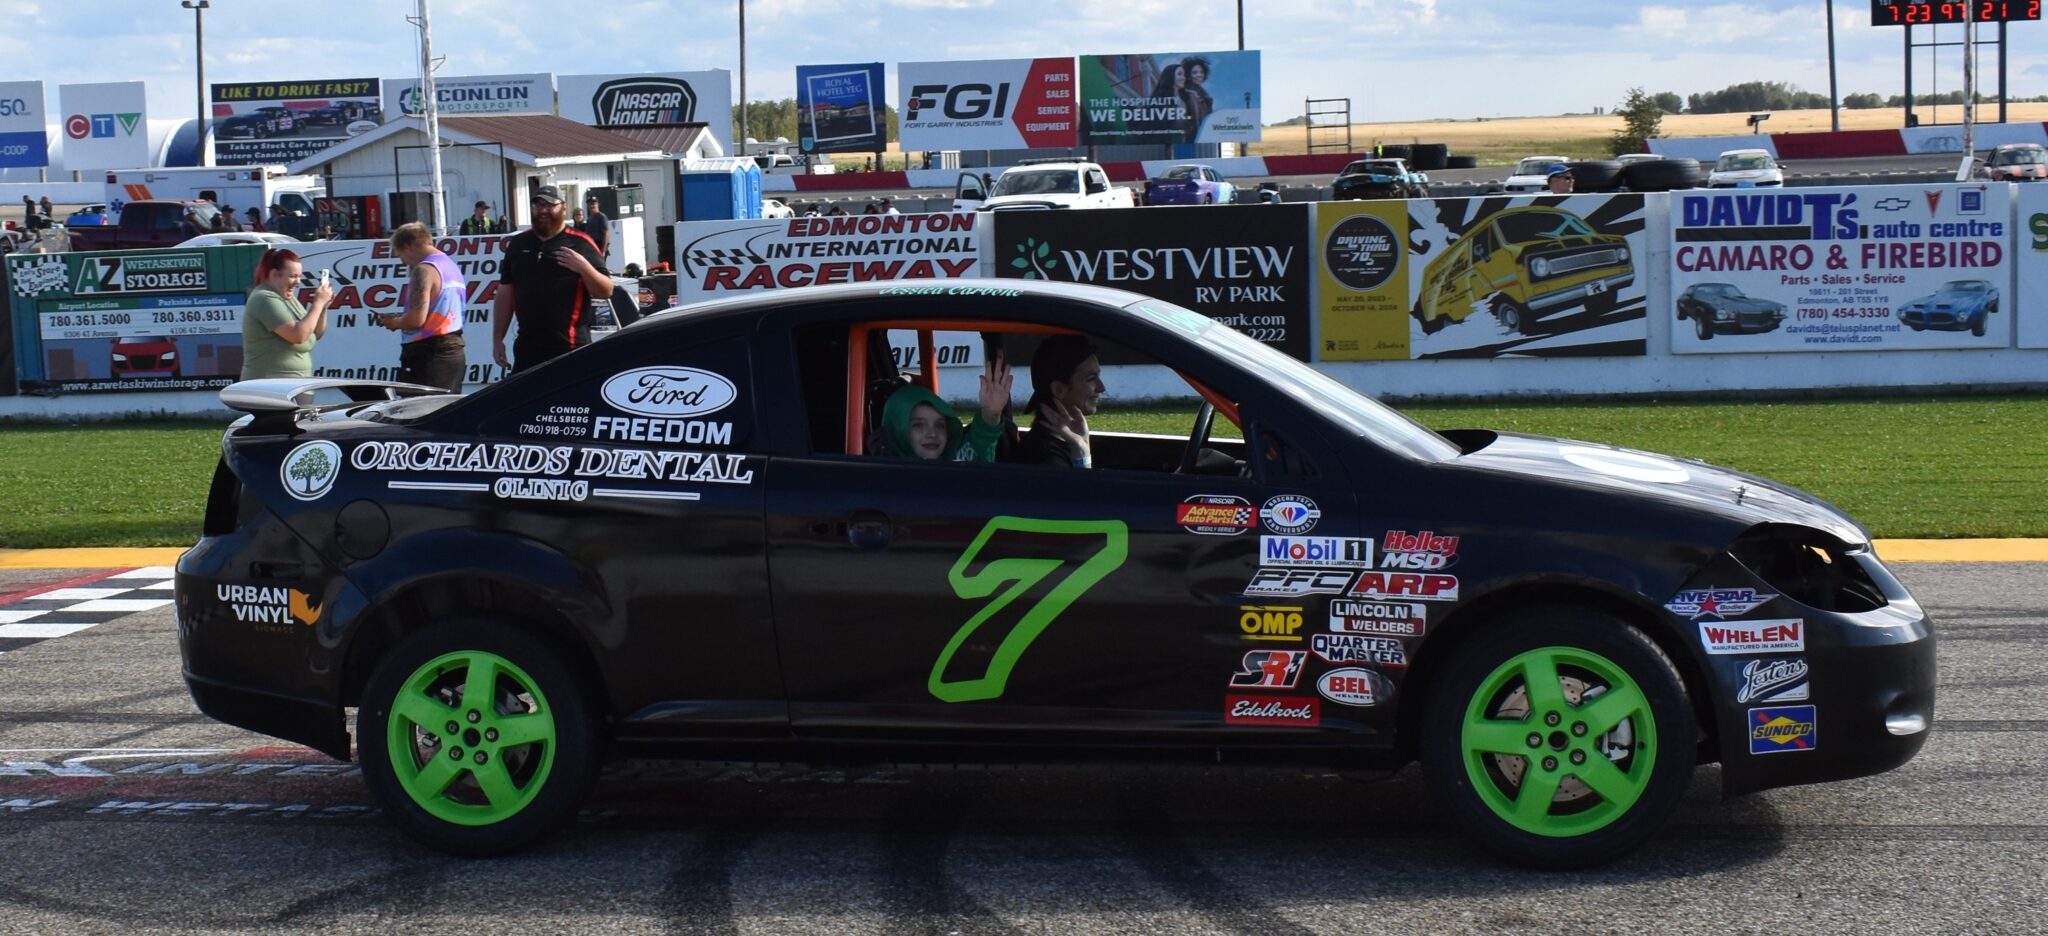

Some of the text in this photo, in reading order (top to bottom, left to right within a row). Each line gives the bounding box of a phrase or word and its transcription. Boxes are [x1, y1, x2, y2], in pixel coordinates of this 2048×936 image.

[1889, 6, 1899, 21] 7
[1906, 5, 1931, 22] 23
[2027, 1, 2040, 17] 2
[825, 78, 853, 88] ROYAL
[1044, 74, 1069, 82] PARTS
[221, 82, 370, 99] LIKE TO DRIVE FAST?
[437, 86, 528, 102] CONLON
[817, 87, 844, 98] HOTEL
[1046, 90, 1070, 98] SALES
[437, 101, 529, 111] MOTORSPORTS
[617, 92, 682, 110] NASCAR
[907, 83, 1010, 120] FGI
[1090, 96, 1180, 108] THE HOSPITALITY
[609, 110, 656, 125] HOME
[1038, 106, 1070, 115] SERVICE
[1090, 108, 1191, 122] WE DELIVER.
[67, 114, 141, 138] CTV
[955, 120, 1003, 128] INDUSTRIES
[1026, 123, 1070, 132] EQUIPMENT
[255, 150, 294, 158] Canada's
[1683, 194, 1803, 227] DAVID
[787, 213, 976, 238] EDMONTON
[1874, 218, 2003, 239] auto centre
[766, 237, 978, 259] INTERNATIONAL
[1336, 235, 1388, 246] DRIVING
[1360, 244, 1391, 252] THRU
[126, 257, 202, 270] WETASKIWIN
[1061, 245, 1294, 281] WESTVIEW
[1676, 241, 2002, 273] CAMARO & FIREBIRD
[76, 257, 121, 293] AZ
[127, 272, 205, 288] STORAGE
[702, 258, 978, 291] RACEWAY
[1781, 273, 1905, 285] Parts Sales Service
[1195, 286, 1286, 304] RV PARK
[1854, 287, 1878, 295] Street
[58, 301, 119, 311] Airport Location
[158, 297, 227, 306] Parkside Location
[1798, 297, 1840, 305] Edmonton,
[1843, 296, 1854, 304] AB
[49, 313, 131, 328] 780.361.5000
[152, 309, 235, 323] 780.360.9311
[337, 314, 356, 328] IN
[1797, 307, 1890, 321] (780) 454-3330
[199, 326, 220, 334] Street
[1786, 323, 1901, 335] davidts@telusplanet.net
[1804, 334, 1882, 344] www.davidt.com
[62, 377, 233, 392] www.azwetaskiwinstorage.com
[628, 374, 709, 407] Ford
[549, 406, 590, 415] CONNOR
[535, 414, 589, 423] CHELSBERG
[519, 423, 586, 436] (780) 918-0759
[593, 416, 733, 446] FREEDOM
[351, 441, 754, 484] ORCHARDS DENTAL
[494, 477, 588, 502] CLINIC
[1269, 497, 1295, 508] NASCAR
[1187, 506, 1234, 515] Advance
[1181, 515, 1231, 524] Auto Parts
[1267, 518, 1315, 533] ANNIVERSARY
[1267, 538, 1337, 560] Mobil
[1383, 530, 1459, 557] Holley
[1380, 553, 1447, 570] MSD
[1251, 570, 1353, 589] PFC
[1353, 572, 1457, 595] ARP
[217, 584, 288, 604] URBAN
[1669, 590, 1753, 603] FIVE STAR
[232, 604, 294, 625] VINYL
[928, 515, 1128, 703] 7
[1335, 603, 1408, 619] LINCOLN
[1240, 612, 1303, 634] OMP
[1352, 619, 1415, 633] WELDERS
[1704, 622, 1798, 644] WHELEN
[1313, 635, 1399, 653] QUARTER
[1712, 644, 1760, 652] MANUFACTURED
[1328, 649, 1403, 664] MASTER
[1231, 651, 1305, 686] SRI
[1738, 660, 1807, 703] Jostens
[1231, 701, 1312, 719] Edelbrock
[1755, 723, 1810, 738] SUNOCO
